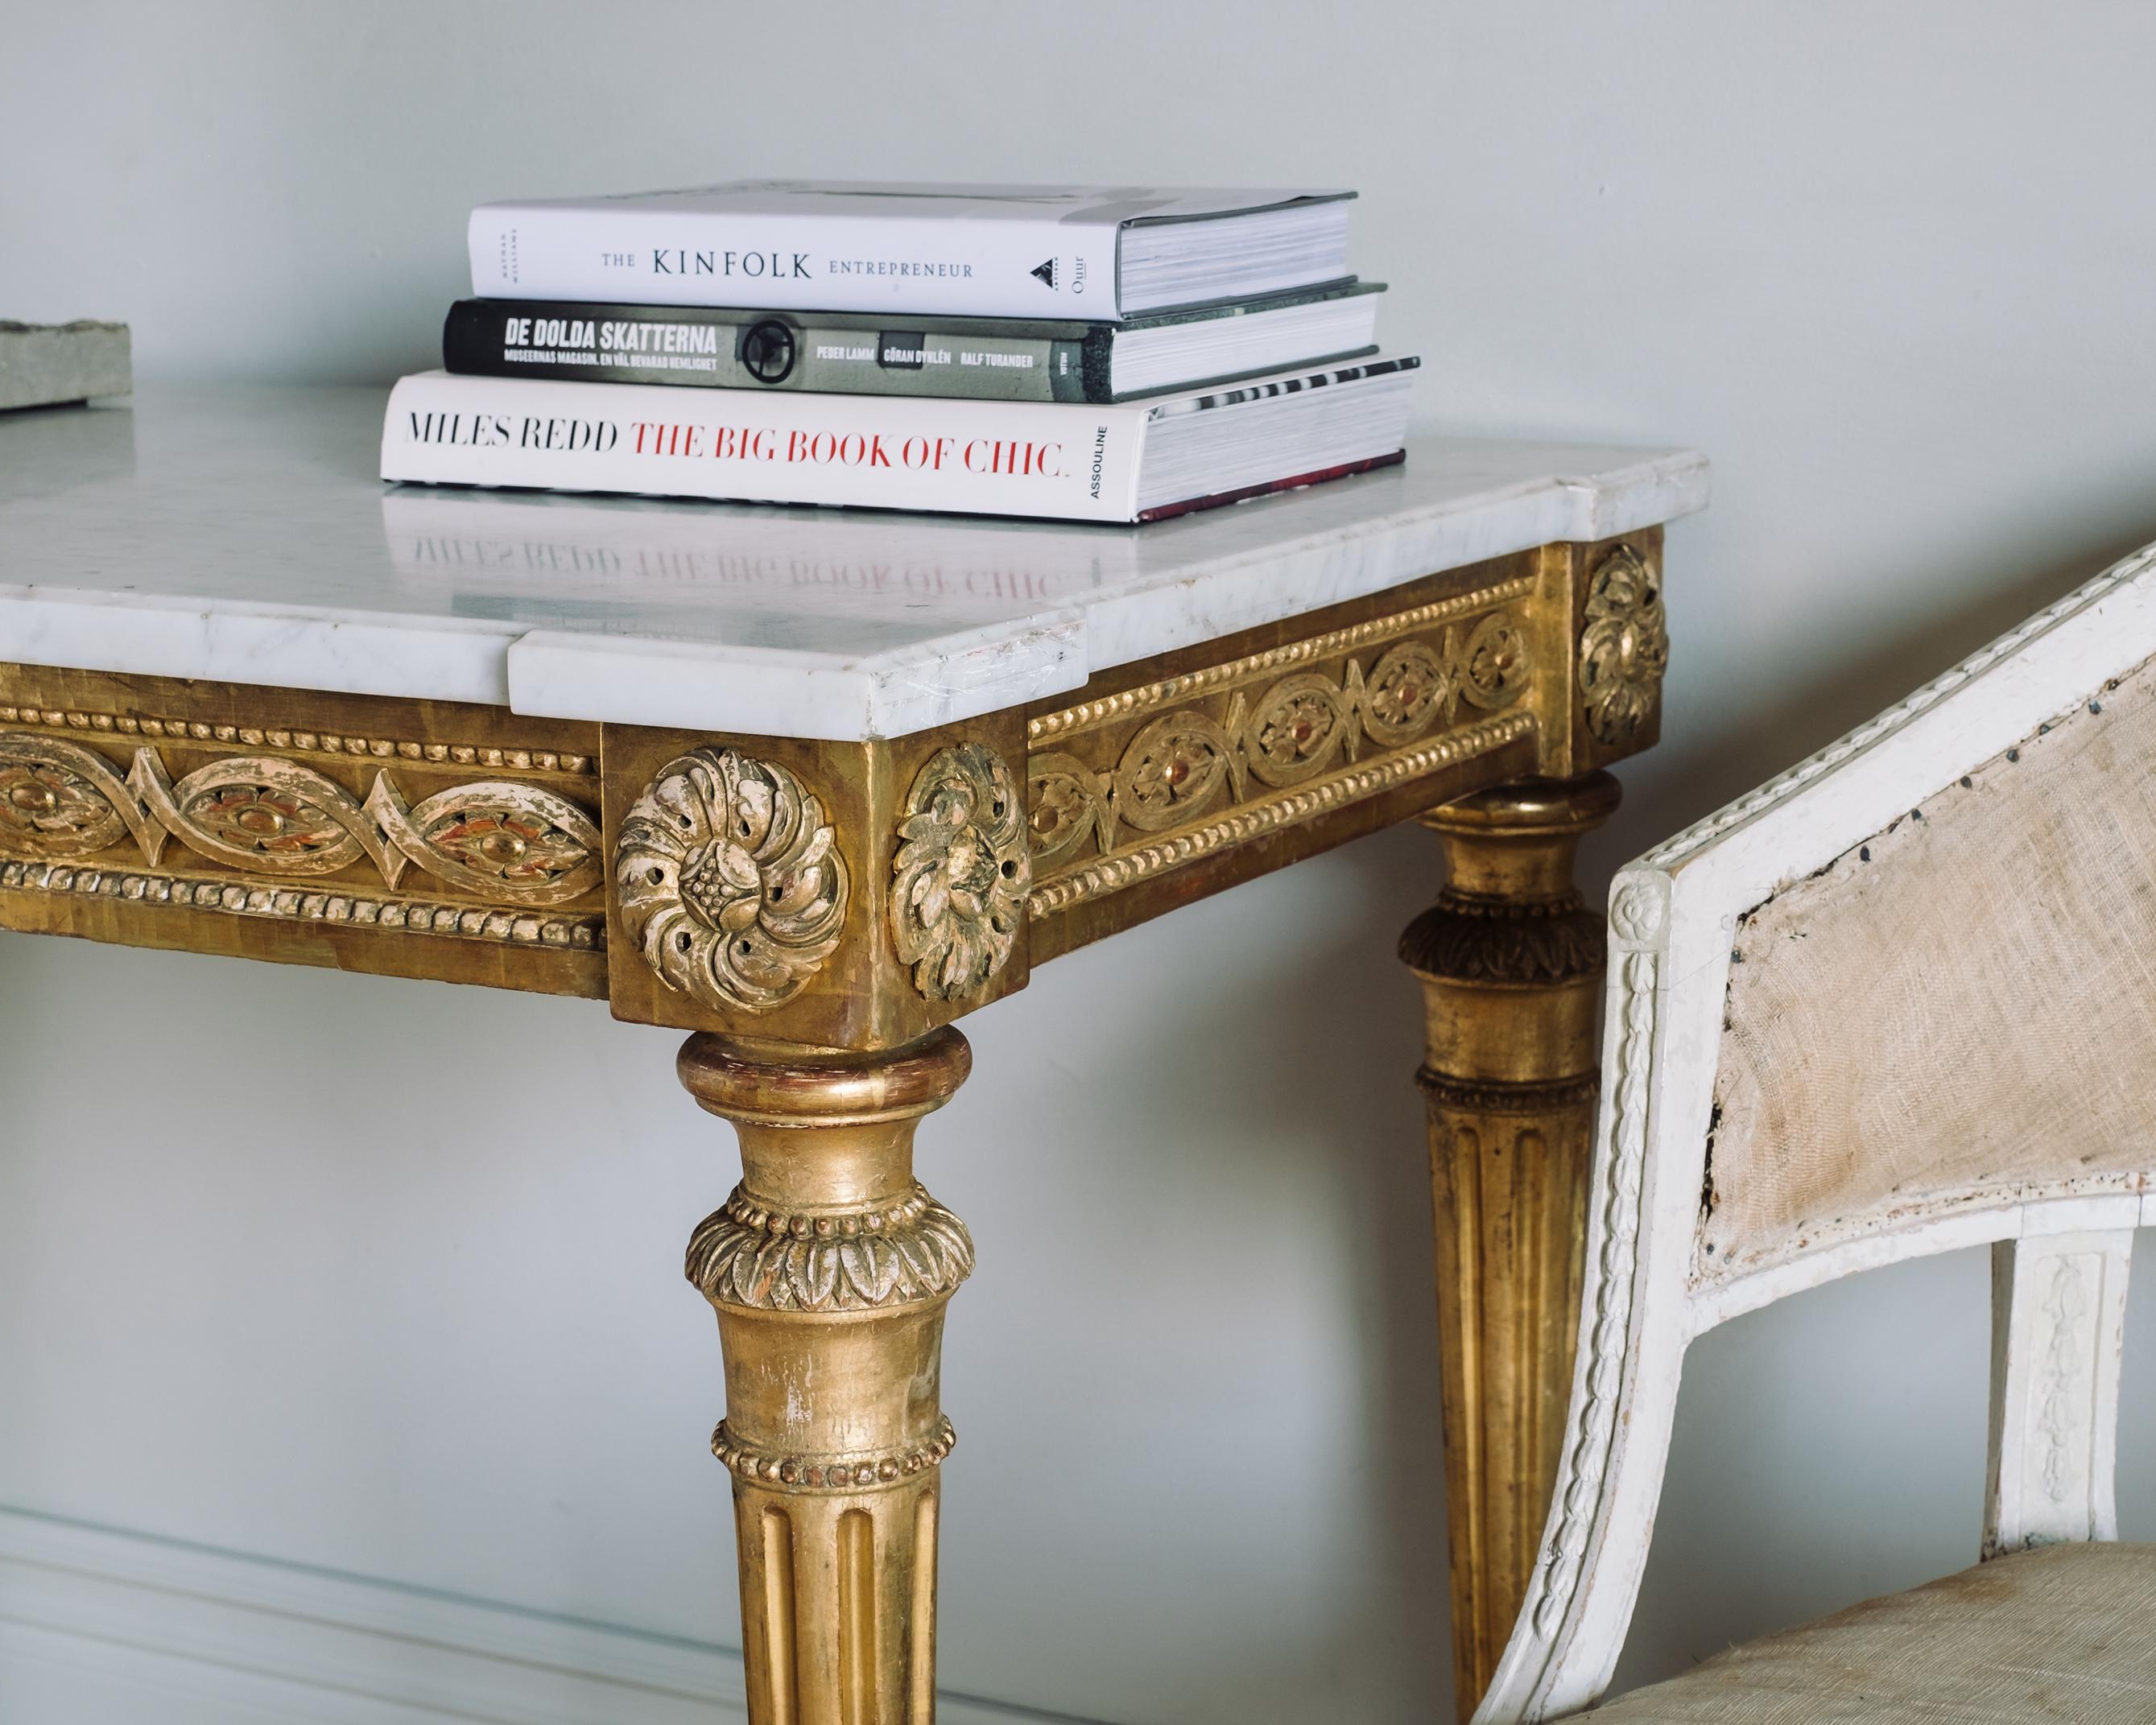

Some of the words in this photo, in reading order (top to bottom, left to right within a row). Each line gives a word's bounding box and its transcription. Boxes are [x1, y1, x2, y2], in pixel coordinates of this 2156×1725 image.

[601, 254, 635, 267] THE
[652, 250, 813, 279] KINFOLK
[829, 259, 973, 279] ENTREPRENEUR
[1072, 255, 1084, 295] Ouur
[504, 317, 531, 346] DE
[533, 319, 595, 349] DOLDA
[599, 321, 717, 354] SKATTERNA
[600, 353, 613, 366] EN
[816, 345, 845, 360] PEDER
[846, 348, 874, 361] LAMM
[883, 347, 915, 363] GÖRAN
[915, 349, 952, 365] DYHLÉN
[960, 352, 984, 366] RALF
[985, 353, 1034, 368] TURANDER
[1059, 352, 1068, 376] VOTUM
[404, 411, 511, 448] MILES
[520, 416, 618, 453] REDD
[631, 423, 704, 458] THE
[713, 427, 777, 463] BIG
[787, 430, 894, 468] BOOK
[902, 435, 956, 471] OF
[964, 439, 1071, 478] CHIC.
[1091, 426, 1108, 500] ASSOULINE
